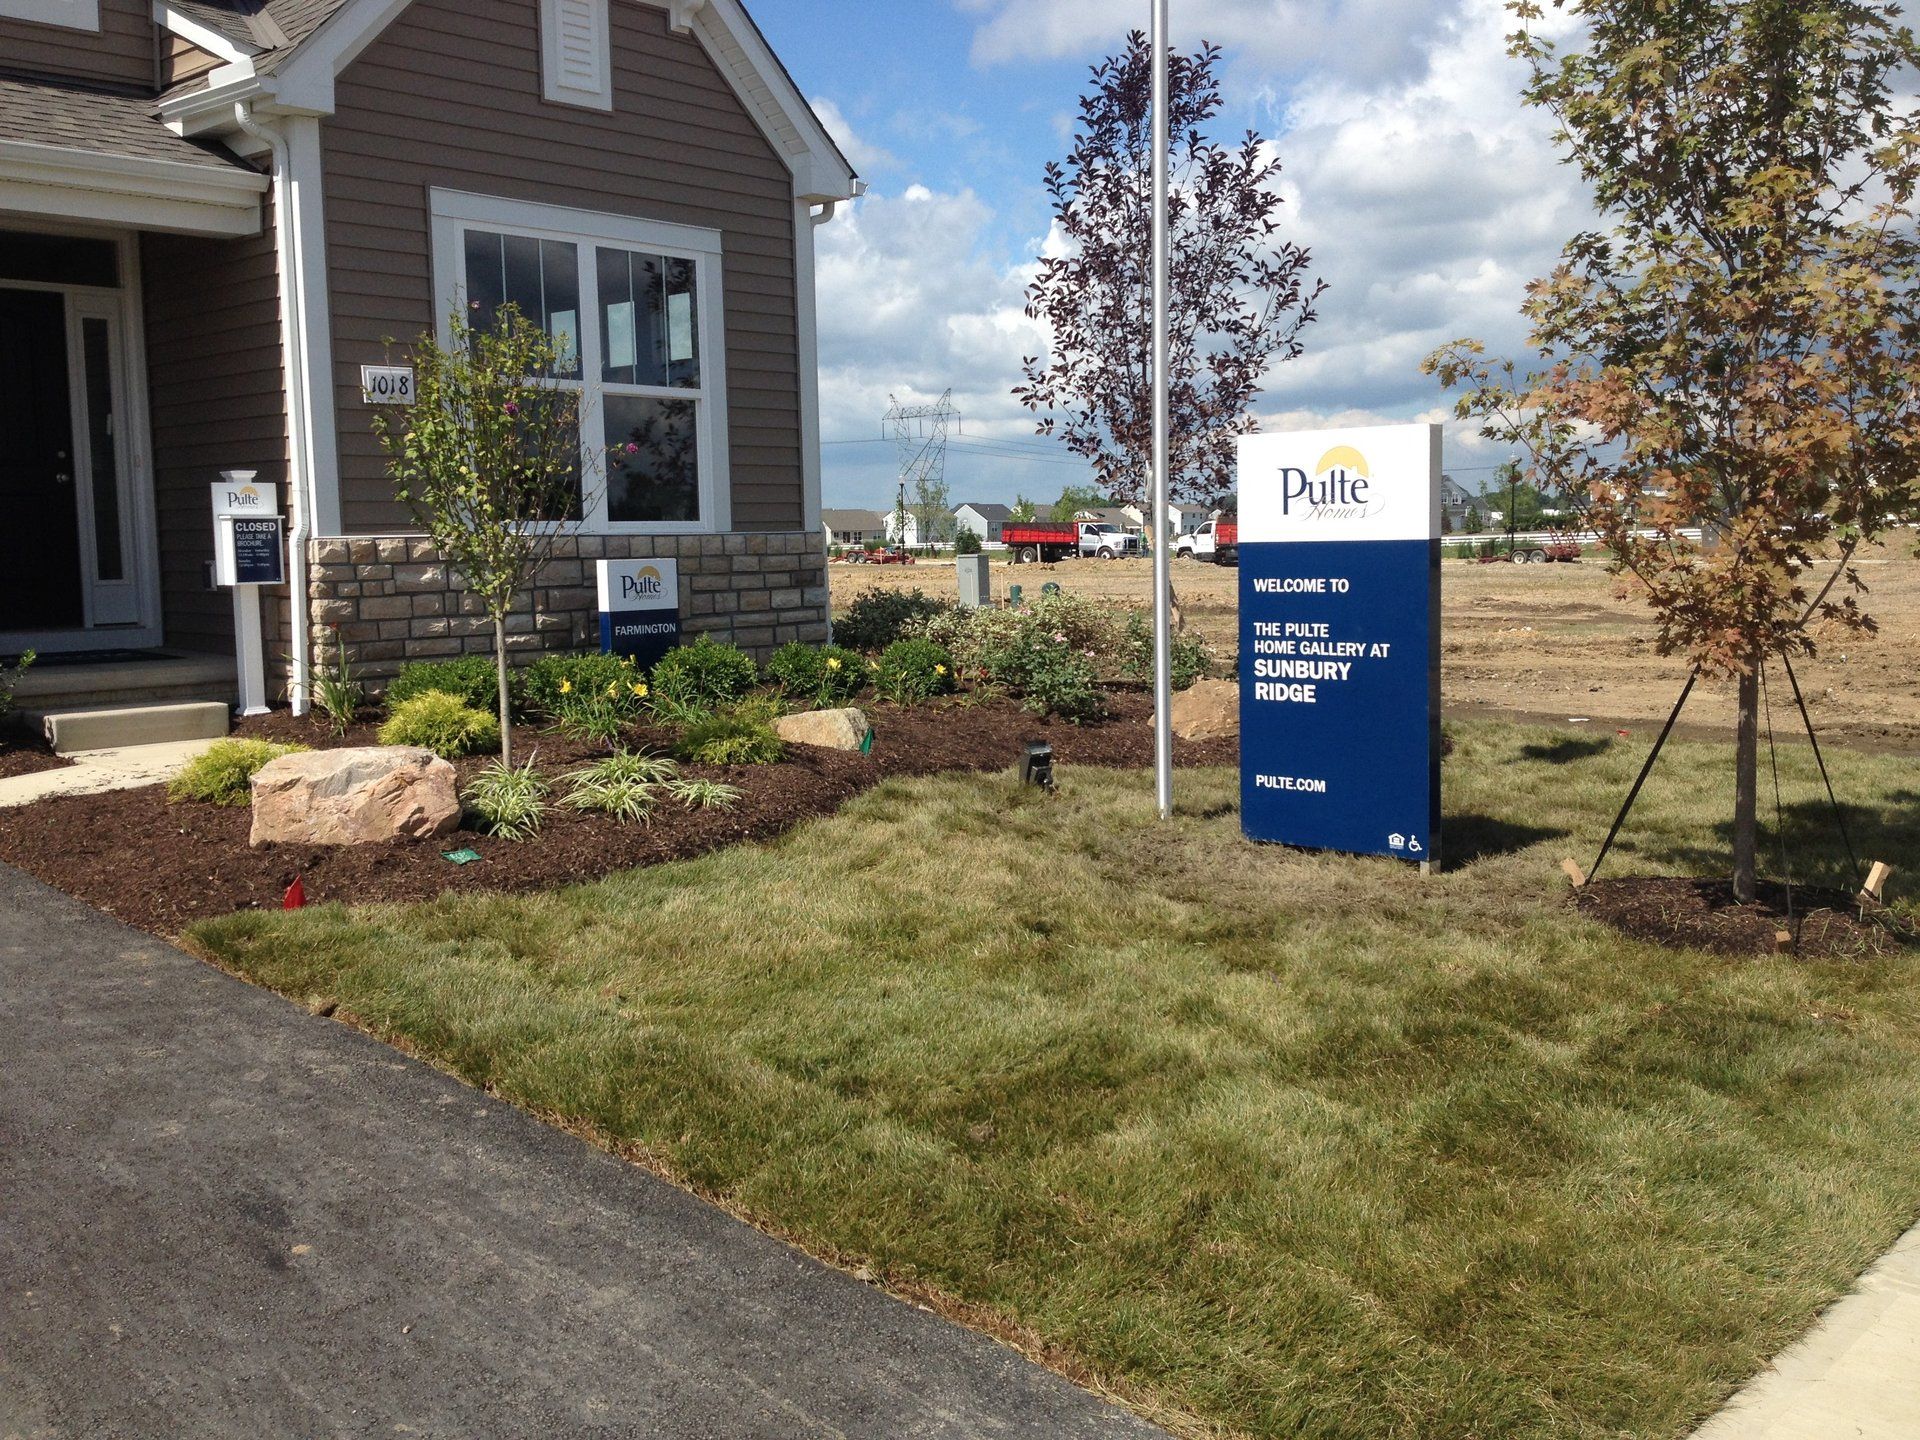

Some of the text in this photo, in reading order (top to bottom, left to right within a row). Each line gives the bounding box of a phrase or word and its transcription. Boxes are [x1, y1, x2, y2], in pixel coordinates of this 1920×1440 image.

[372, 375, 409, 395] 1018
[227, 492, 258, 508] Pulte
[1278, 467, 1369, 515] Pulte
[1296, 493, 1386, 521] Homes
[235, 522, 276, 532] CLOSED
[620, 575, 662, 599] Pulte
[1253, 578, 1350, 593] WELCOME TO
[615, 623, 676, 636] FARMINGTON
[1253, 622, 1330, 638] THE PULTE
[1254, 640, 1391, 658] HOME GALLERY AT
[1254, 659, 1352, 681] SUNBURY
[1255, 682, 1317, 703] RIDGE
[1255, 774, 1326, 793] PULTE.COM
